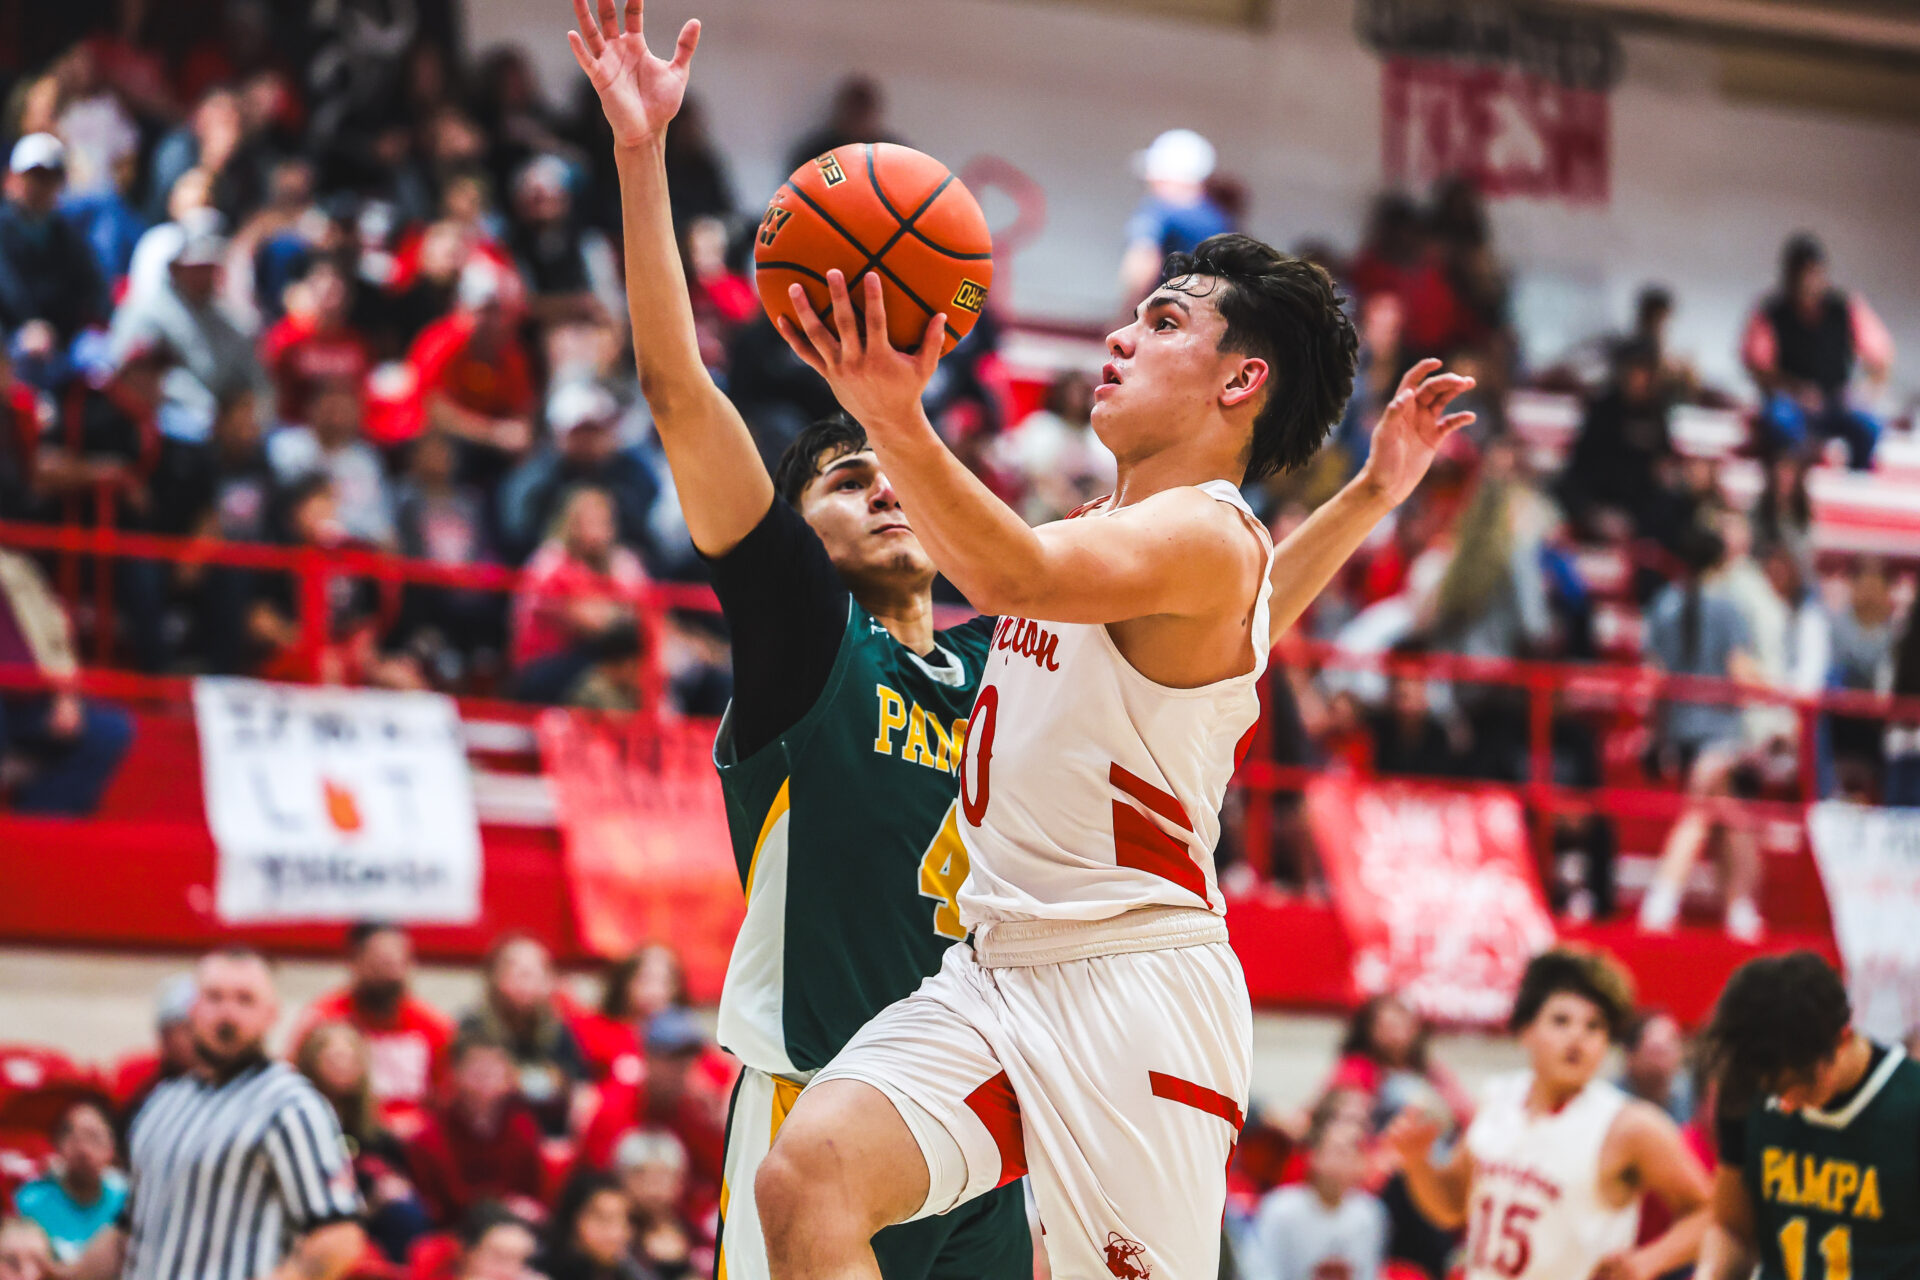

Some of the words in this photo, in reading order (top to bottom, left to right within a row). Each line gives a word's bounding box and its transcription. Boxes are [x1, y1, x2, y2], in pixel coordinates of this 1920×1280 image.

[873, 683, 968, 778] PAM
[1762, 1146, 1883, 1220] PAMPA
[1472, 1195, 1541, 1279] 15
